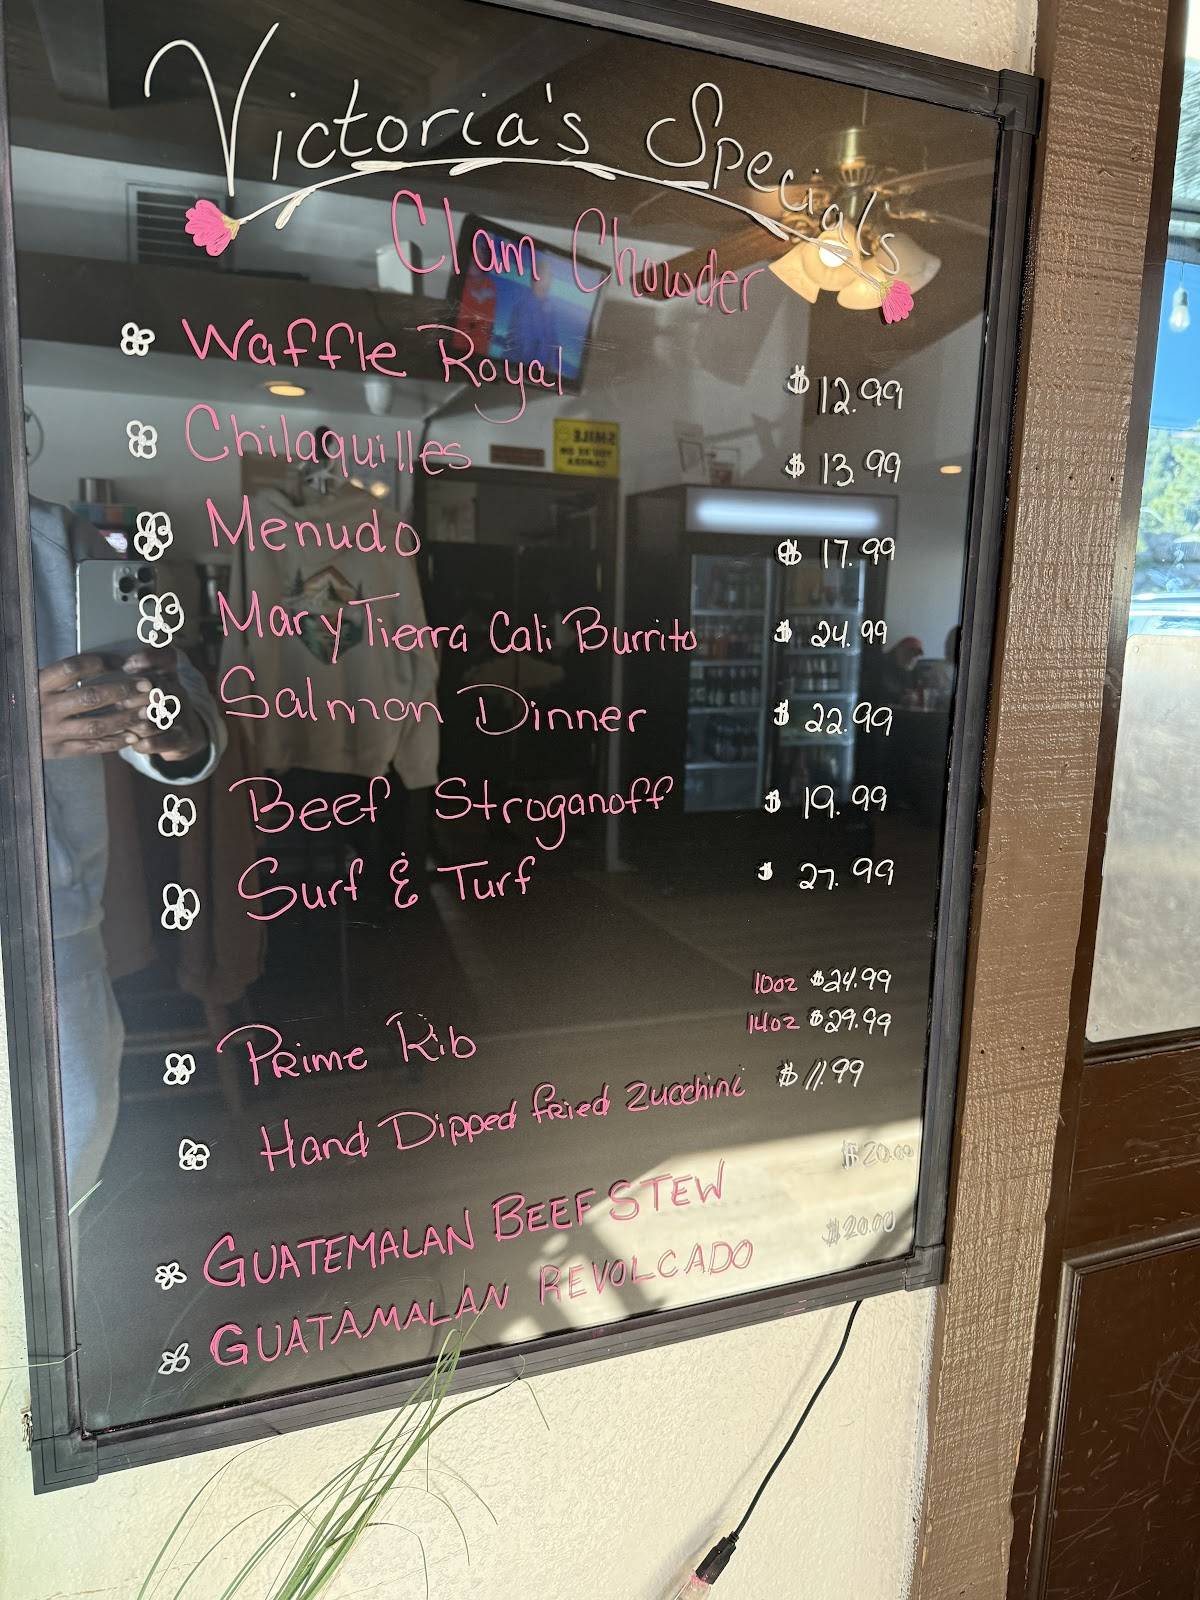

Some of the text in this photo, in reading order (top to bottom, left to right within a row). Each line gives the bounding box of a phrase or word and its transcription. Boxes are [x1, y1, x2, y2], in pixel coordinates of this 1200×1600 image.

[143, 23, 900, 275] Victoria's Specials
[391, 189, 765, 315] Clam Chowder
[181, 317, 563, 424] Waffle Royal
[185, 403, 472, 476] Chilaquilles
[205, 495, 420, 558] Menudo
[489, 610, 552, 654] Cali
[562, 606, 697, 656] Burrito
[219, 664, 647, 736] Salmon Dinner
[228, 775, 674, 851] Beef Stroganoff
[237, 852, 537, 921] Surf & Turf
[386, 1011, 478, 1063] Rib
[259, 1118, 369, 1172] Hand
[377, 1100, 517, 1151] Dipped
[203, 1158, 726, 1289] GUATEMALAN BEEF STEW
[210, 1239, 754, 1368] GUATAMALAN REVOLCADO
